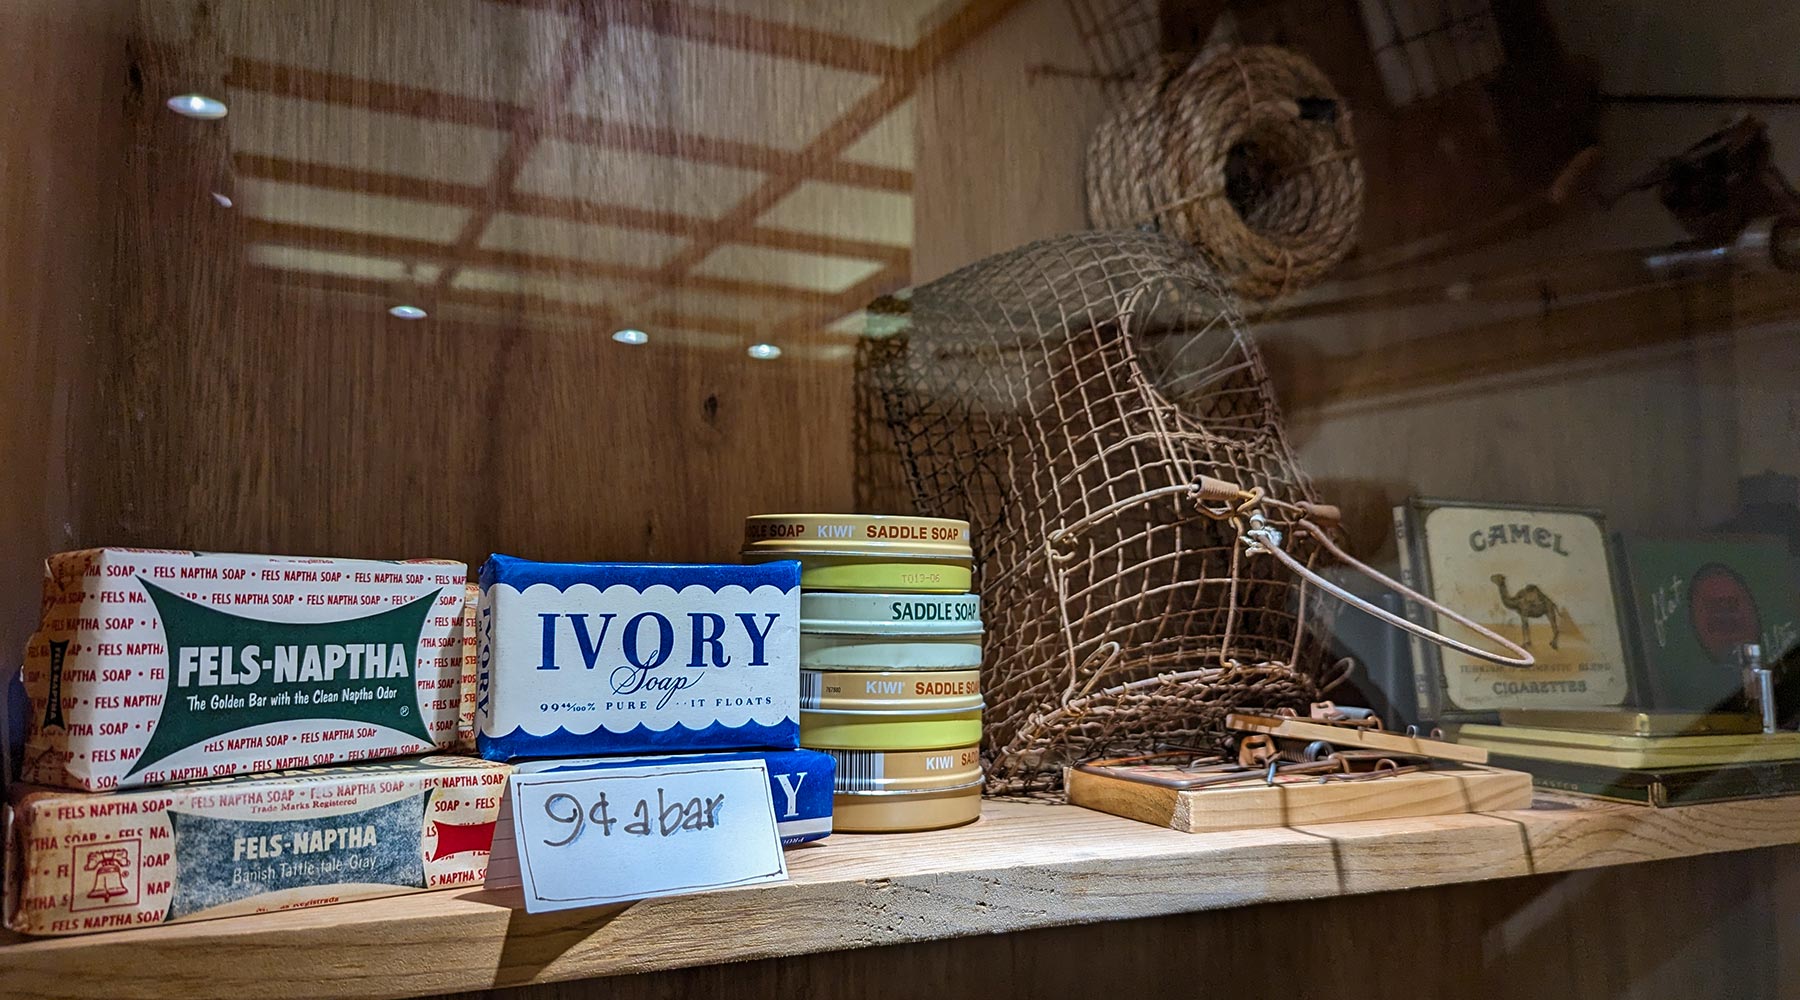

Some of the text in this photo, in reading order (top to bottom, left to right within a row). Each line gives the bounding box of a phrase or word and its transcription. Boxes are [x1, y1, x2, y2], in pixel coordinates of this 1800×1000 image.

[769, 524, 805, 537] SOAP
[817, 525, 853, 538] KIWI
[866, 525, 928, 540] SADDLE
[931, 527, 959, 540] SOAP
[1468, 524, 1569, 557] CAMEL
[106, 565, 135, 577] SOAP
[154, 566, 176, 578] FELS
[180, 568, 218, 580] NAPTHA
[222, 569, 246, 580] SOAP
[261, 570, 280, 581] FELS
[284, 570, 317, 582] NAPTHA
[320, 572, 342, 582] SOAP
[355, 572, 371, 583] FELS
[374, 573, 403, 584] NAPTHA
[406, 574, 424, 584] SOAP
[436, 576, 450, 584] FELS
[101, 592, 124, 603] FELS
[212, 594, 231, 604] FELS
[234, 594, 268, 604] NAPTHA
[272, 594, 294, 605] SOAP
[306, 594, 325, 605] FELS
[328, 594, 358, 605] NAPTHA
[360, 594, 380, 605] SOAP
[440, 596, 457, 606] SOAP
[892, 602, 976, 620] SADDLE SOAP
[106, 618, 134, 630] SOAP
[434, 617, 448, 626] FELS
[440, 638, 455, 647] SOAP
[536, 612, 780, 670] IVORY
[98, 644, 122, 656] FELS
[178, 644, 409, 687] FELS-NAPTHA
[434, 658, 448, 668] FELS
[103, 669, 132, 682] SOAP
[610, 650, 705, 710] Soap
[438, 679, 454, 689] SOAP
[866, 681, 903, 694] KIWI
[916, 682, 964, 696] SADDLE
[1492, 680, 1588, 695] CIGARETTES
[95, 696, 120, 709] FELS
[187, 686, 398, 711] The Golden Bar with the Clean Naptha Odor
[432, 700, 446, 710] FELS
[606, 701, 648, 710] PURE
[716, 697, 772, 707] FLOATS
[100, 722, 128, 736] SOAP
[436, 720, 454, 731] SOAP
[228, 737, 262, 750] NAPTHA
[266, 735, 289, 746] SOAP
[301, 732, 320, 744] FELS
[322, 730, 354, 742] NAPTHA
[92, 750, 116, 762] FELS
[926, 756, 954, 770] KIWI
[144, 771, 165, 784] FELS
[170, 766, 208, 781] NAPTHA
[212, 764, 237, 776] SOAP
[254, 760, 272, 772] FELS
[276, 756, 309, 770] NAPTHA
[313, 753, 334, 766] SOAP
[368, 747, 398, 759] NAPTHA
[401, 744, 420, 754] SOAP
[58, 806, 84, 820] FELS
[90, 802, 138, 818] NAPTHA
[142, 800, 172, 813] SOAP
[220, 792, 264, 807] NAPTHA
[267, 790, 294, 803] SOAP
[337, 784, 376, 796] NAPTHA
[380, 781, 404, 793] SOAP
[442, 775, 478, 788] NAPTHA
[482, 774, 504, 786] SOAP
[434, 797, 495, 812] SOAP FELS
[252, 798, 357, 814] Trade Marks Registered
[544, 790, 618, 847] 9¢
[658, 787, 725, 837] bar
[232, 826, 378, 861] FELS-NAPTHA
[233, 865, 276, 884] Banish
[348, 854, 378, 874] Gray
[440, 870, 475, 884] NAPTHA
[52, 919, 79, 932] FELS
[84, 914, 132, 929] NAPTHA
